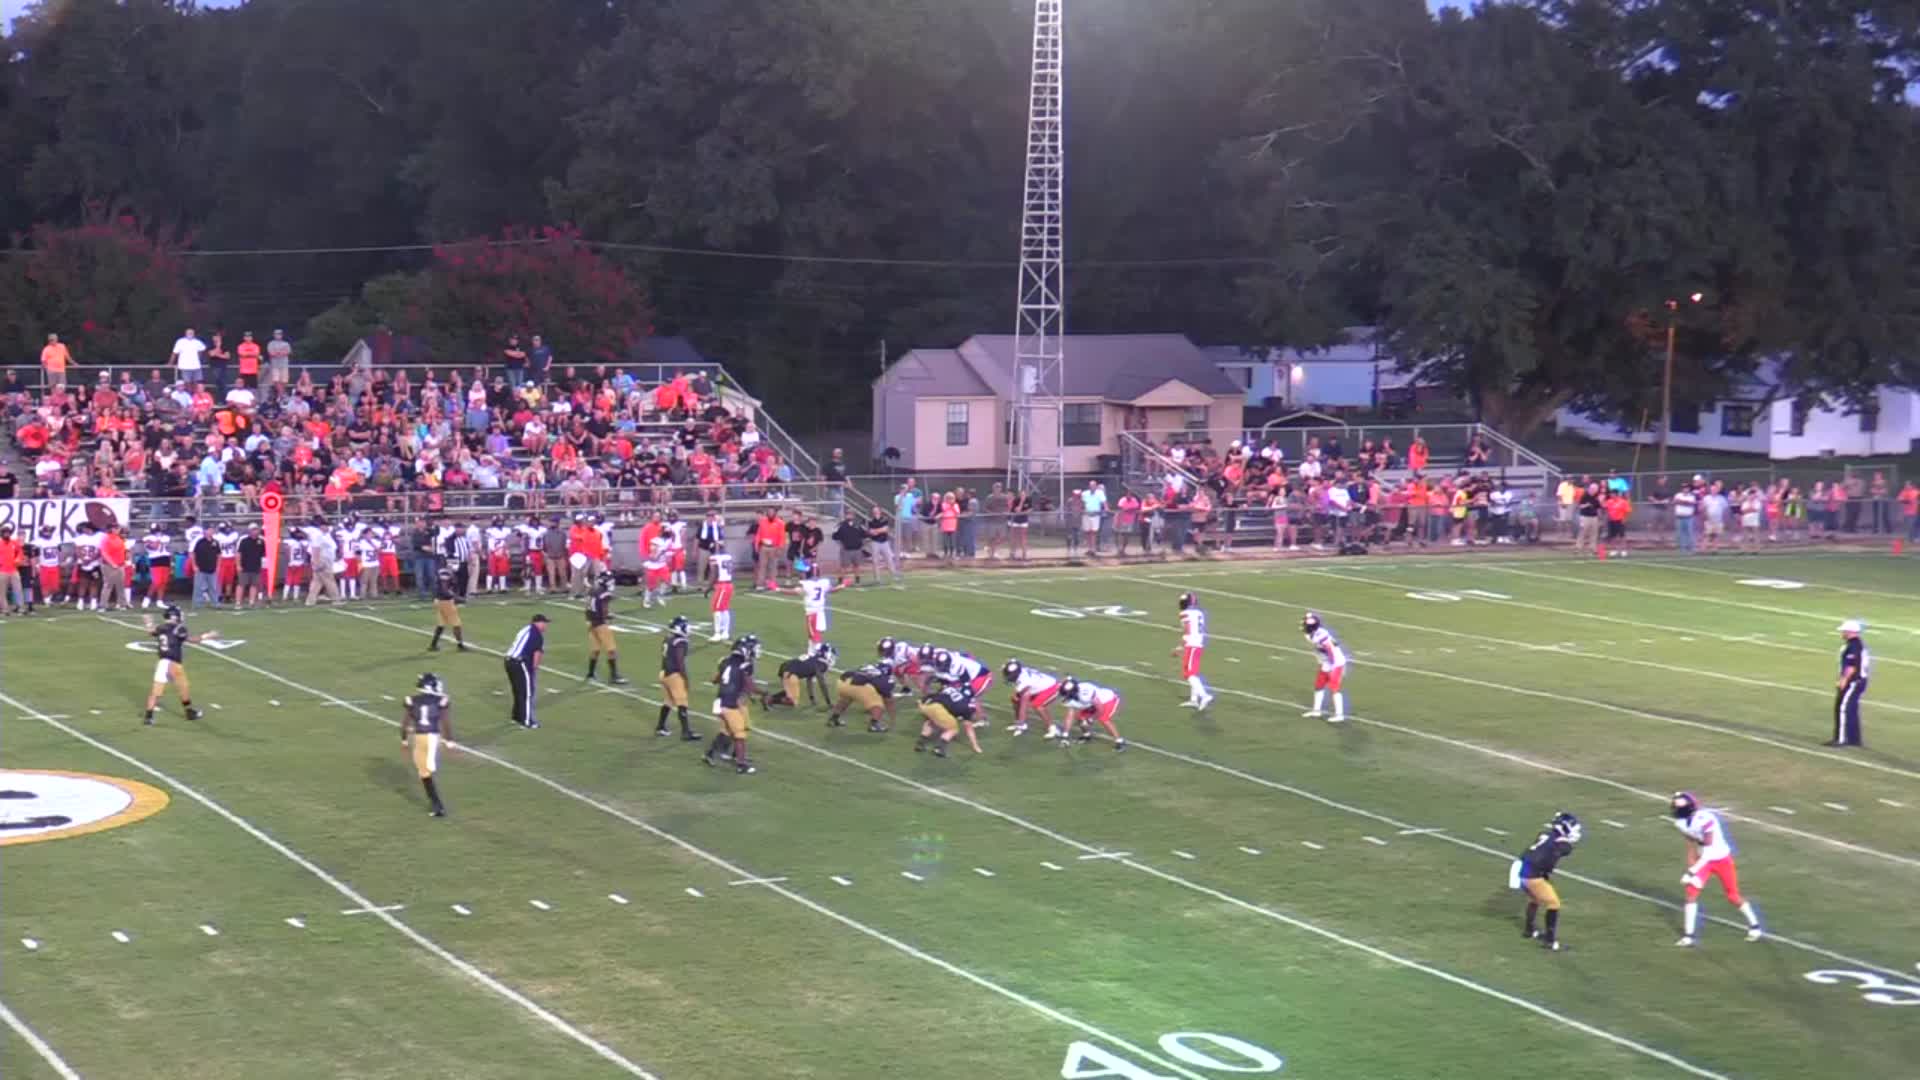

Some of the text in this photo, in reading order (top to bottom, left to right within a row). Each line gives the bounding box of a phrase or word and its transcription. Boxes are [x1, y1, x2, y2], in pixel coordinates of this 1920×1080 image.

[813, 588, 822, 600] 3
[721, 665, 732, 685] 4
[419, 704, 431, 726] 1
[1803, 962, 1920, 1005] 3
[1061, 1032, 1283, 1080] 40
